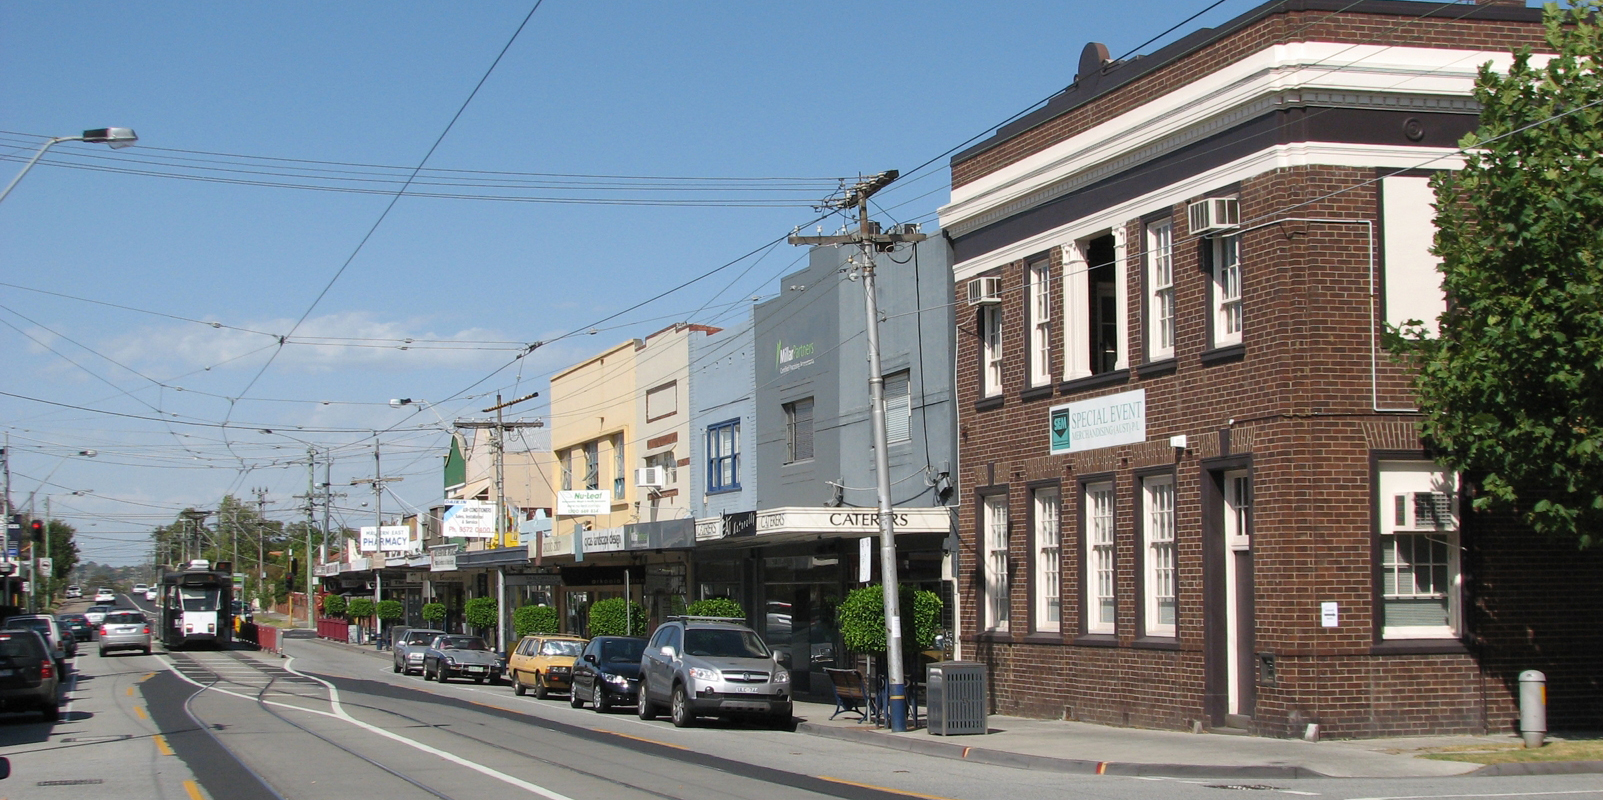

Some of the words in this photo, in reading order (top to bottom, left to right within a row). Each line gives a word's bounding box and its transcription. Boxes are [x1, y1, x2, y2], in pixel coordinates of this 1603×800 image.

[1072, 408, 1108, 429] SPECIAL
[1111, 401, 1142, 422] EVENT
[761, 514, 785, 528] CATERERS
[829, 512, 908, 527] CATERRS
